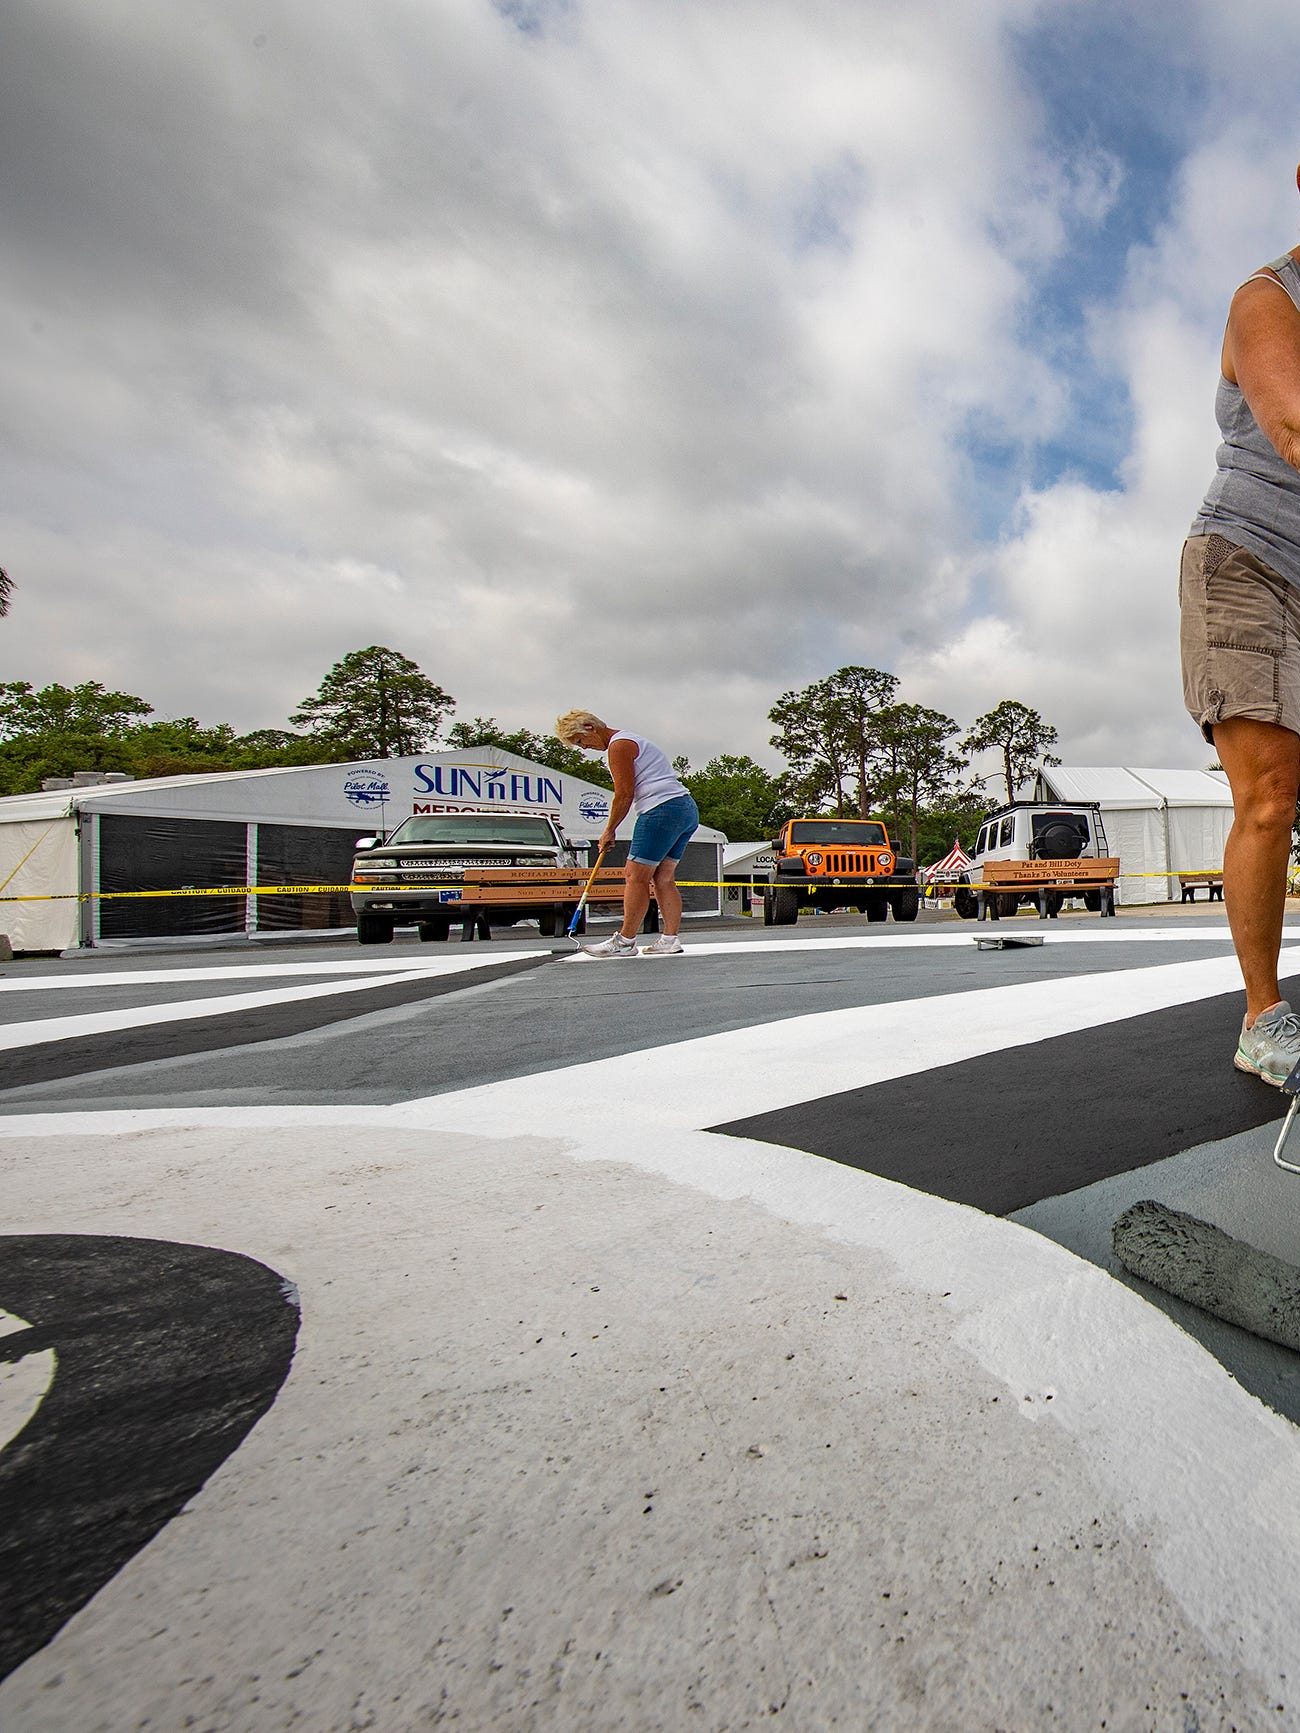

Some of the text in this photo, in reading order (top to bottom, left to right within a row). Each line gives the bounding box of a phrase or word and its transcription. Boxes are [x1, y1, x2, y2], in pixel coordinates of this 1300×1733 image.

[344, 781, 366, 790] Pilot
[413, 764, 481, 798] SUN
[511, 774, 563, 804] FUN
[1049, 860, 1063, 868] Bill
[1064, 860, 1082, 868] Doty
[1013, 871, 1040, 879] Thanks
[1052, 870, 1089, 878] Volunteers
